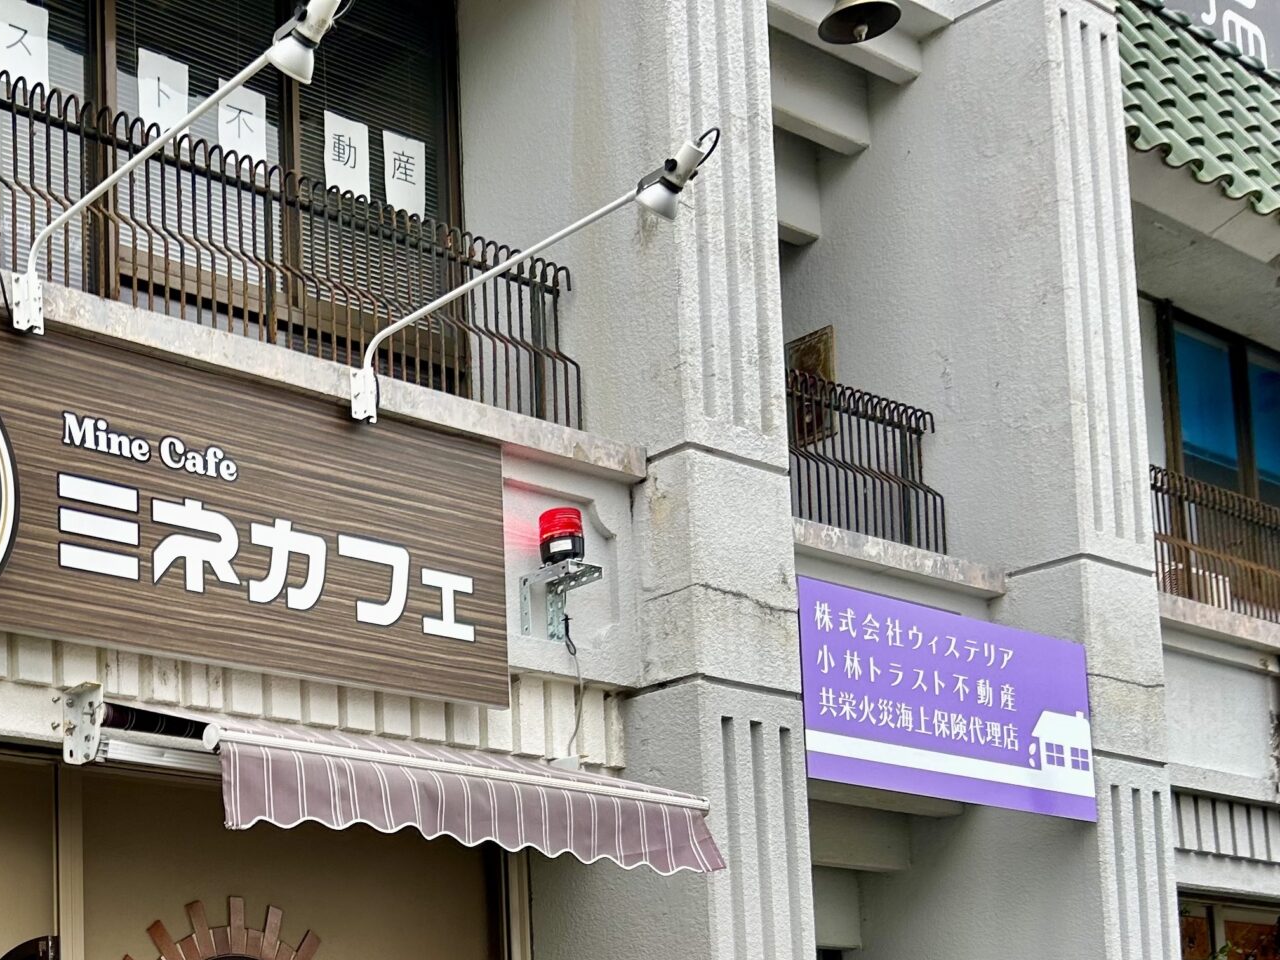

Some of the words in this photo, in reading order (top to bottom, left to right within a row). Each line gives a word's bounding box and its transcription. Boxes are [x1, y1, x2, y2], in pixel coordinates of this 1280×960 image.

[5, 23, 32, 56] ス
[157, 76, 170, 108] ト
[225, 103, 254, 139] 不
[330, 133, 358, 171] 動
[390, 149, 417, 187] 産
[61, 410, 151, 463] Mine
[159, 434, 239, 483] Cafe
[56, 472, 477, 643] ミネカフェ
[814, 600, 1015, 670] 株式会社ウィステリア
[816, 645, 1017, 712] 小林トラスト不動産
[819, 687, 1019, 751] 共栄火災海上保険代理店
